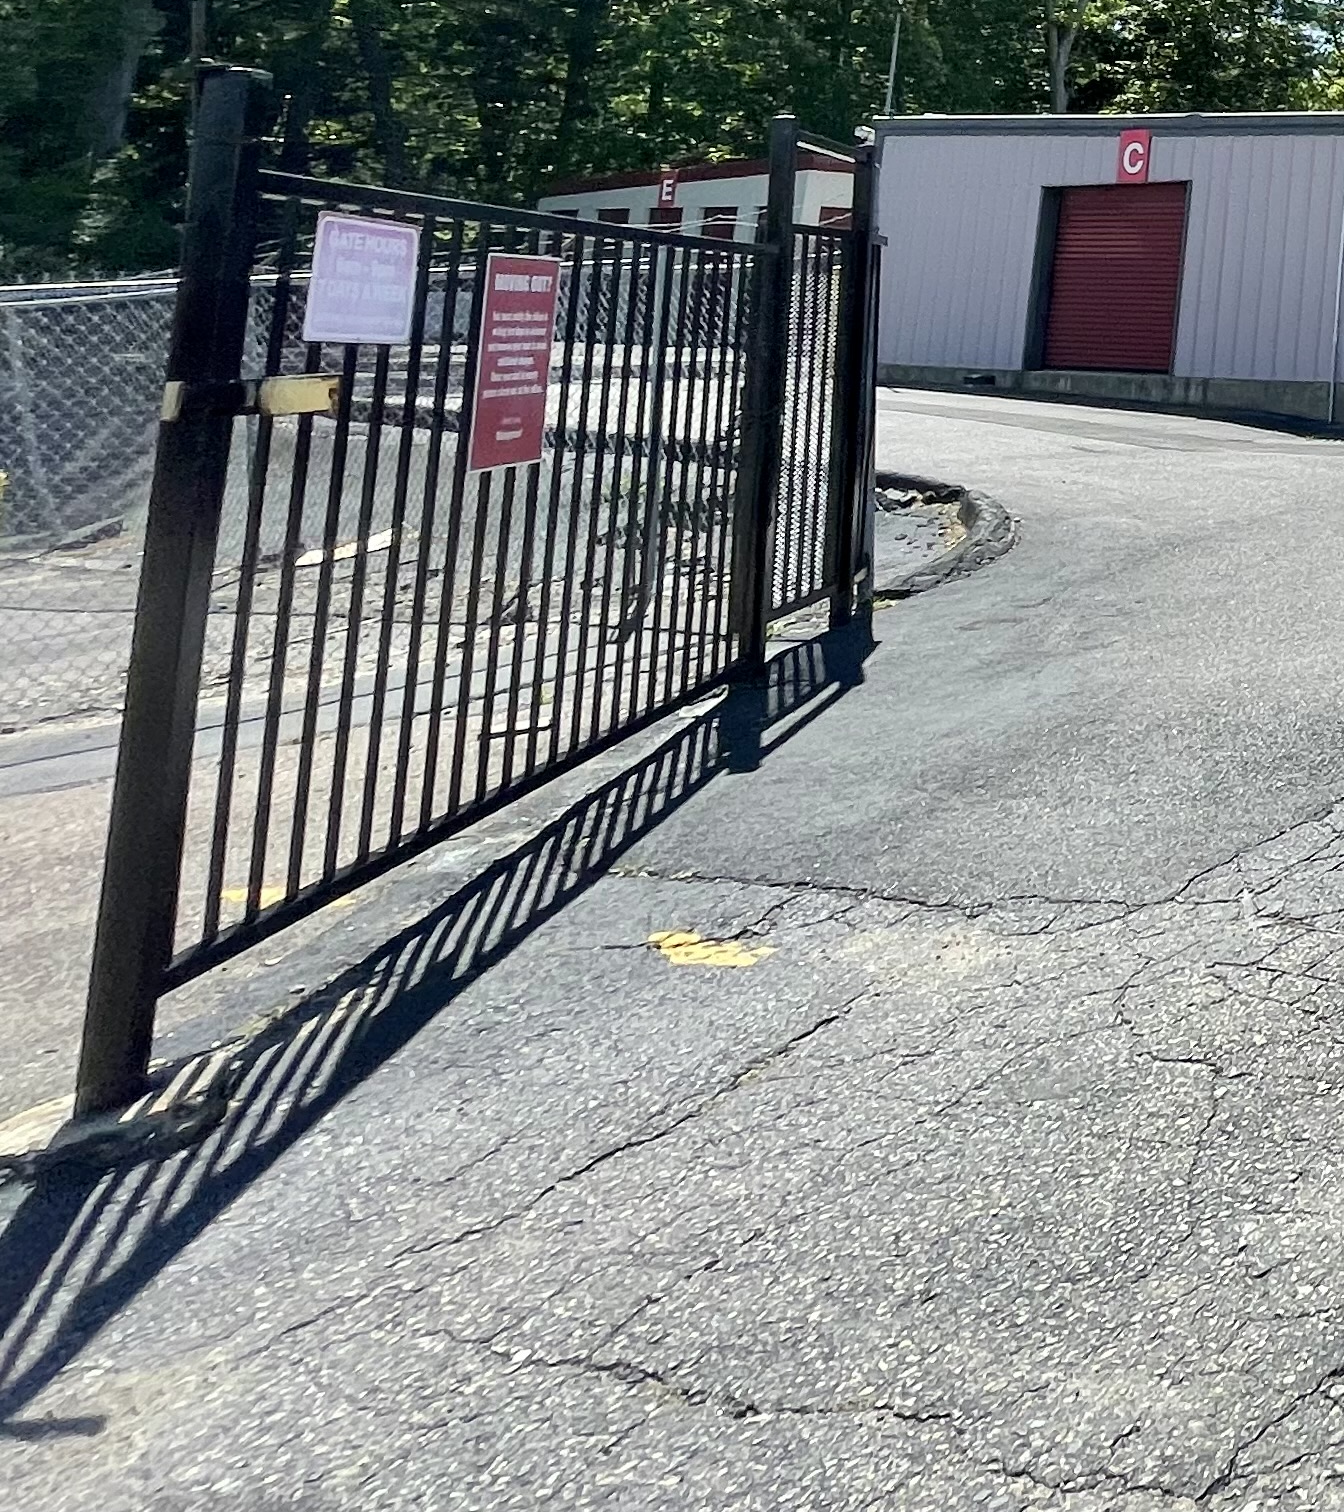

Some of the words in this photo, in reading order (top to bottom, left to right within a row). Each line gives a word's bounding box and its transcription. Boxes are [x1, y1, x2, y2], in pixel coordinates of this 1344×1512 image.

[1123, 142, 1144, 174] C
[661, 179, 674, 201] E
[329, 228, 365, 251] GATE
